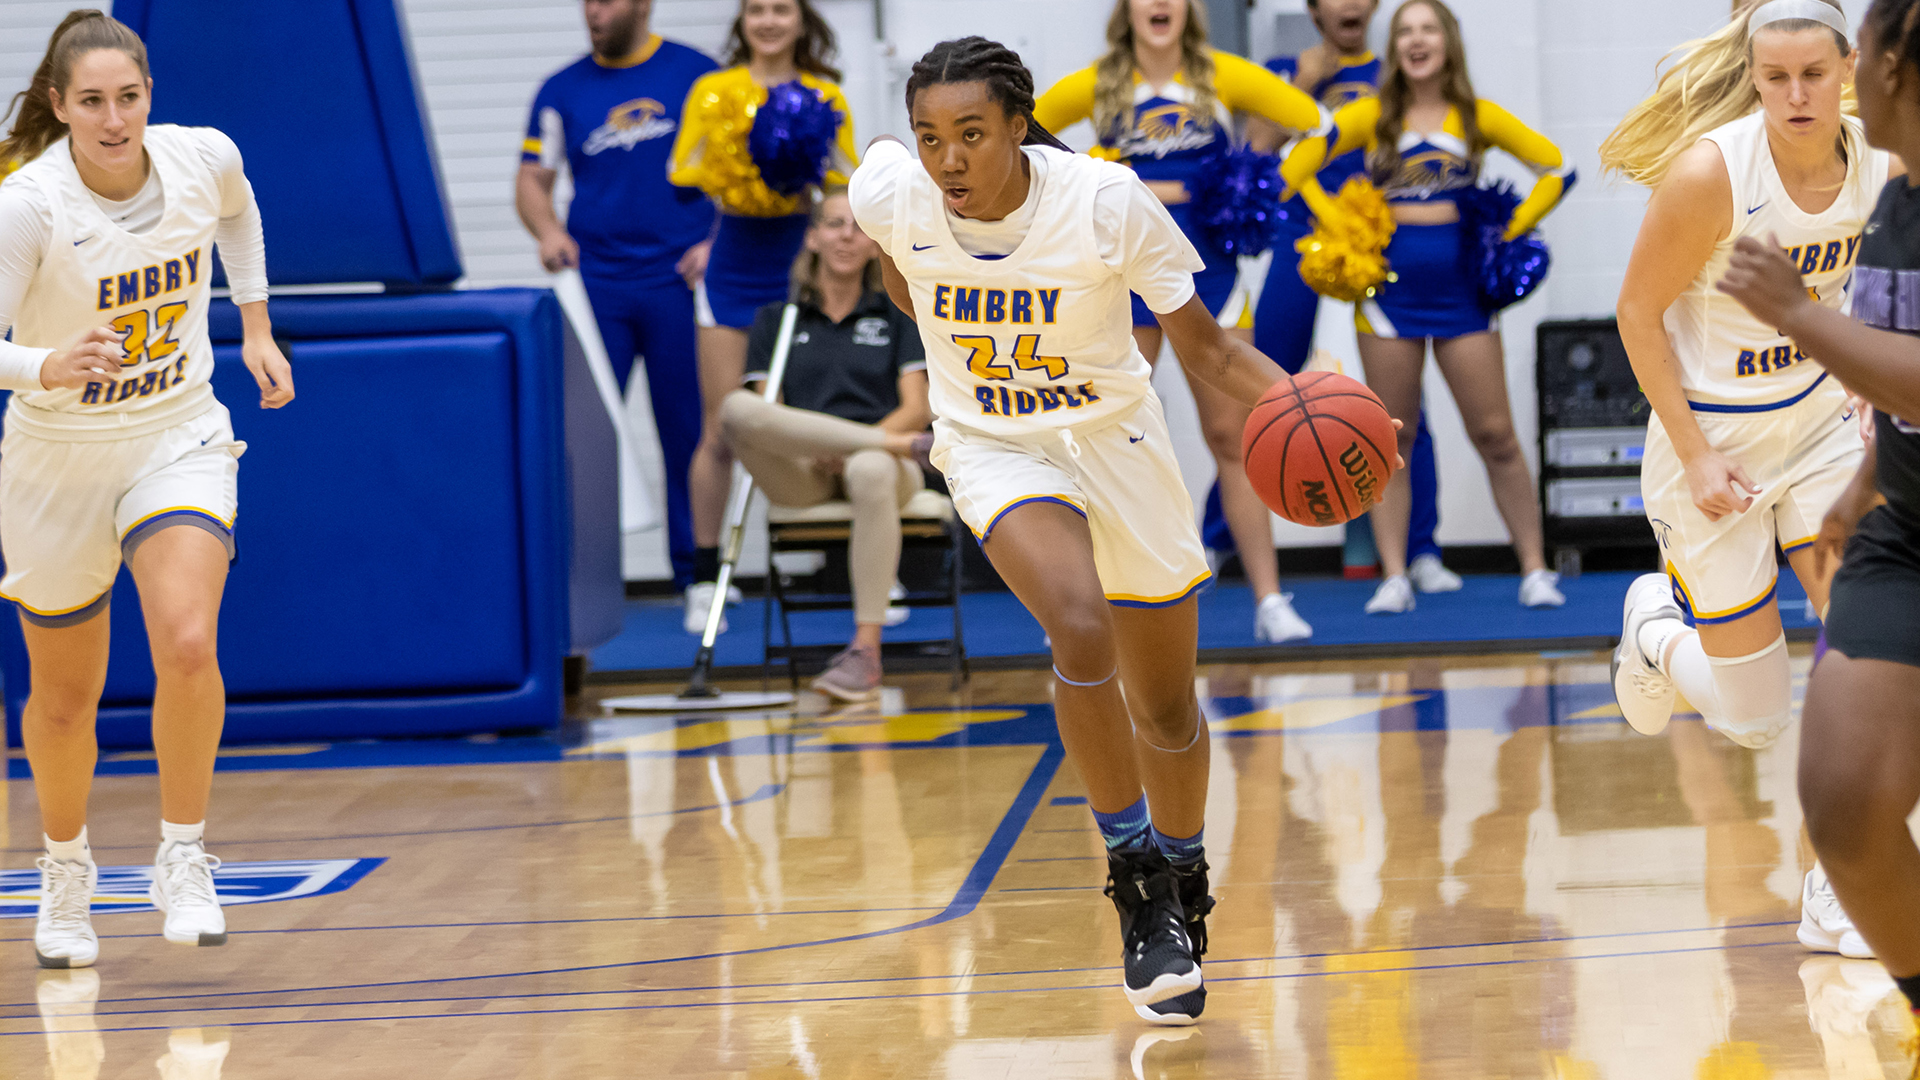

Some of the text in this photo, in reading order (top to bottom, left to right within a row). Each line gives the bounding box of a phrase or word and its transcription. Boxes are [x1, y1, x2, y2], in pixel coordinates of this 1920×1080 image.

[1785, 233, 1862, 276] BRY
[97, 248, 200, 311] EMBRY
[933, 283, 1062, 325] EMBRY
[112, 300, 188, 367] 32
[951, 334, 1070, 380] 24
[1735, 345, 1808, 378] RID
[974, 380, 1101, 417] RIDDLE
[1339, 441, 1378, 511] Wils
[1301, 480, 1340, 525] NCA
